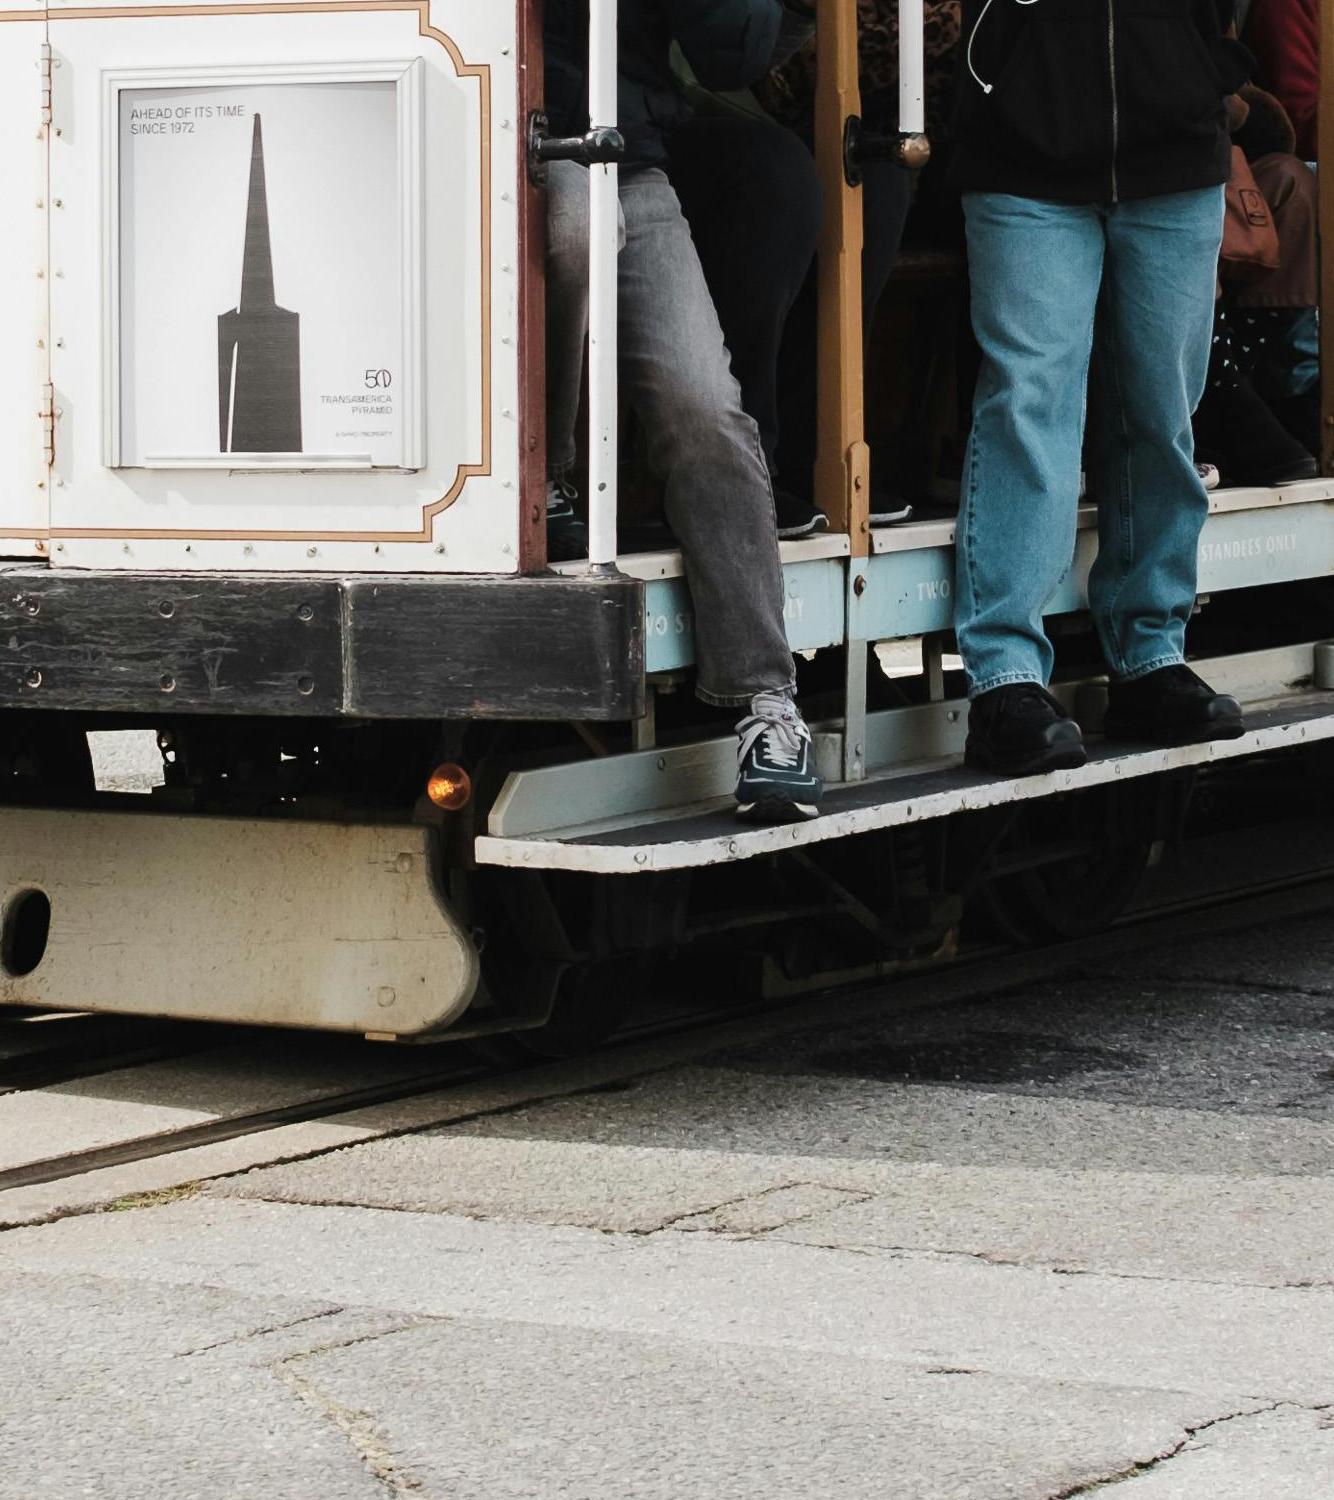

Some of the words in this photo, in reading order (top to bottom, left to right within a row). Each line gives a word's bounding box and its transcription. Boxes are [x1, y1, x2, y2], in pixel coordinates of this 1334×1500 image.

[131, 107, 172, 119] AHEAD
[175, 107, 191, 118] OF
[195, 106, 212, 117] ITS
[216, 105, 244, 116] TIME
[131, 123, 166, 135] SINCE
[171, 122, 194, 133] 1972
[917, 579, 950, 601] TWO
[1200, 536, 1261, 562] STANDEES
[1266, 534, 1297, 552] ONLY
